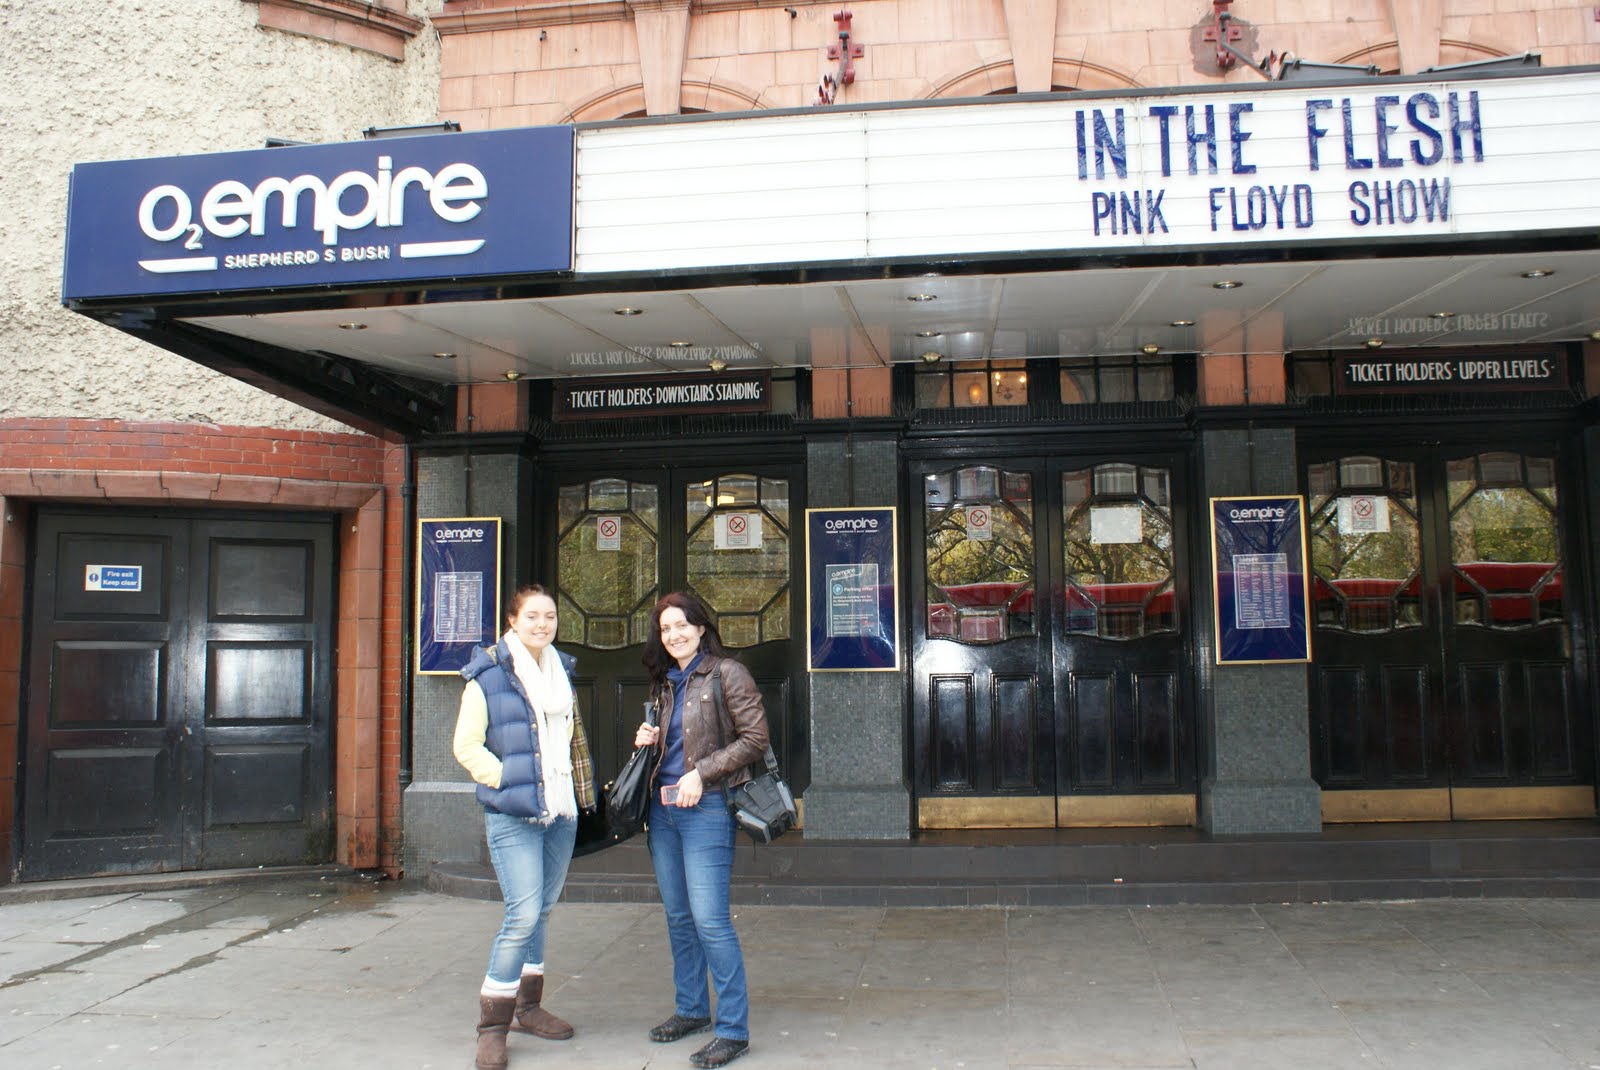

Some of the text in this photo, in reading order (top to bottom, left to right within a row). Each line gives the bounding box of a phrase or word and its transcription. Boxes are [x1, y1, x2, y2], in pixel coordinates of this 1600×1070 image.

[1074, 90, 1485, 181] IN THE FLESH
[1091, 176, 1452, 236] PINK FLOYD SHOW
[341, 245, 391, 261] BUSH
[1349, 359, 1550, 382] TICKET HOLDERS UPPER LEVELS
[570, 382, 761, 408] TICKET HOLDERS DOWNSTAIRS STANDING
